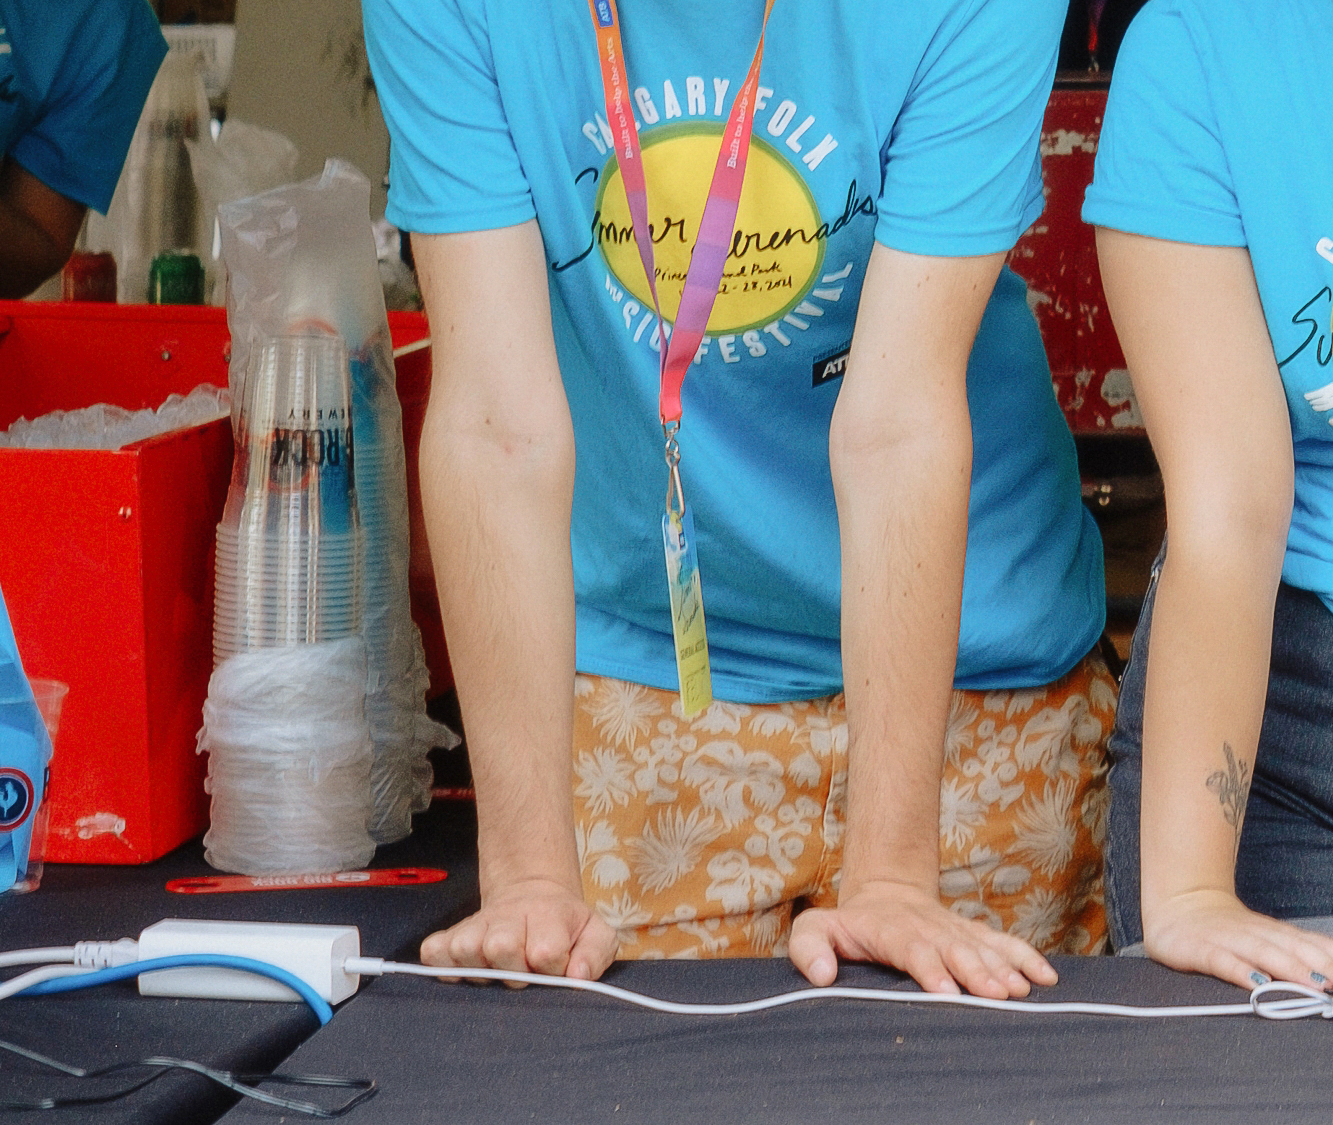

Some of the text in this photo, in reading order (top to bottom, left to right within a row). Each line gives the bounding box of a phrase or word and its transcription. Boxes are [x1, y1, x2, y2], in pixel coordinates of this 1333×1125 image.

[582, 76, 839, 172] CAGARY FOLK
[691, 179, 875, 261] erenades
[693, 261, 853, 364] FESTIVAL
